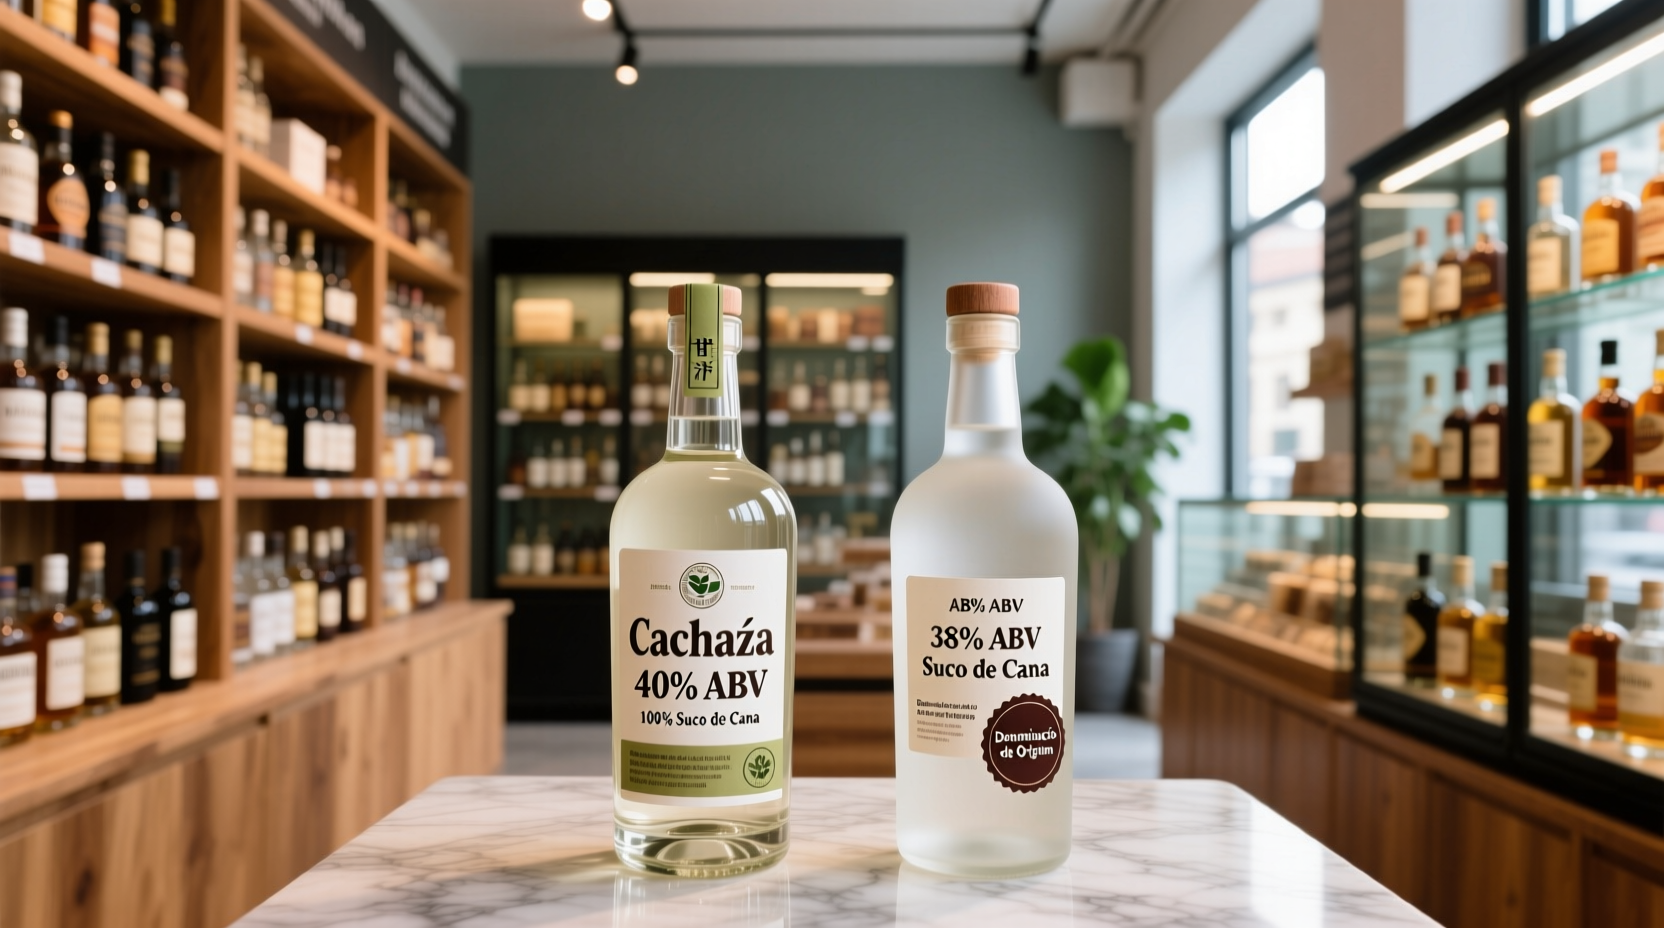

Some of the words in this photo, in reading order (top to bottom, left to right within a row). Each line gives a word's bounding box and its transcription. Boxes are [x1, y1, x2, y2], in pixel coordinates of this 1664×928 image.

[949, 598, 985, 614] AB%
[989, 598, 1024, 613] ABV
[629, 617, 774, 657] Cachaźa
[930, 625, 984, 650] 38%
[988, 626, 1042, 650] ABV
[922, 656, 968, 678] Suco
[973, 658, 997, 679] de
[1002, 659, 1049, 679] Cana
[634, 669, 698, 700] 40%
[703, 669, 768, 700] ABV
[641, 710, 673, 726] 100%
[676, 711, 707, 726] Suco
[710, 711, 726, 726] de
[729, 711, 760, 725] Cana
